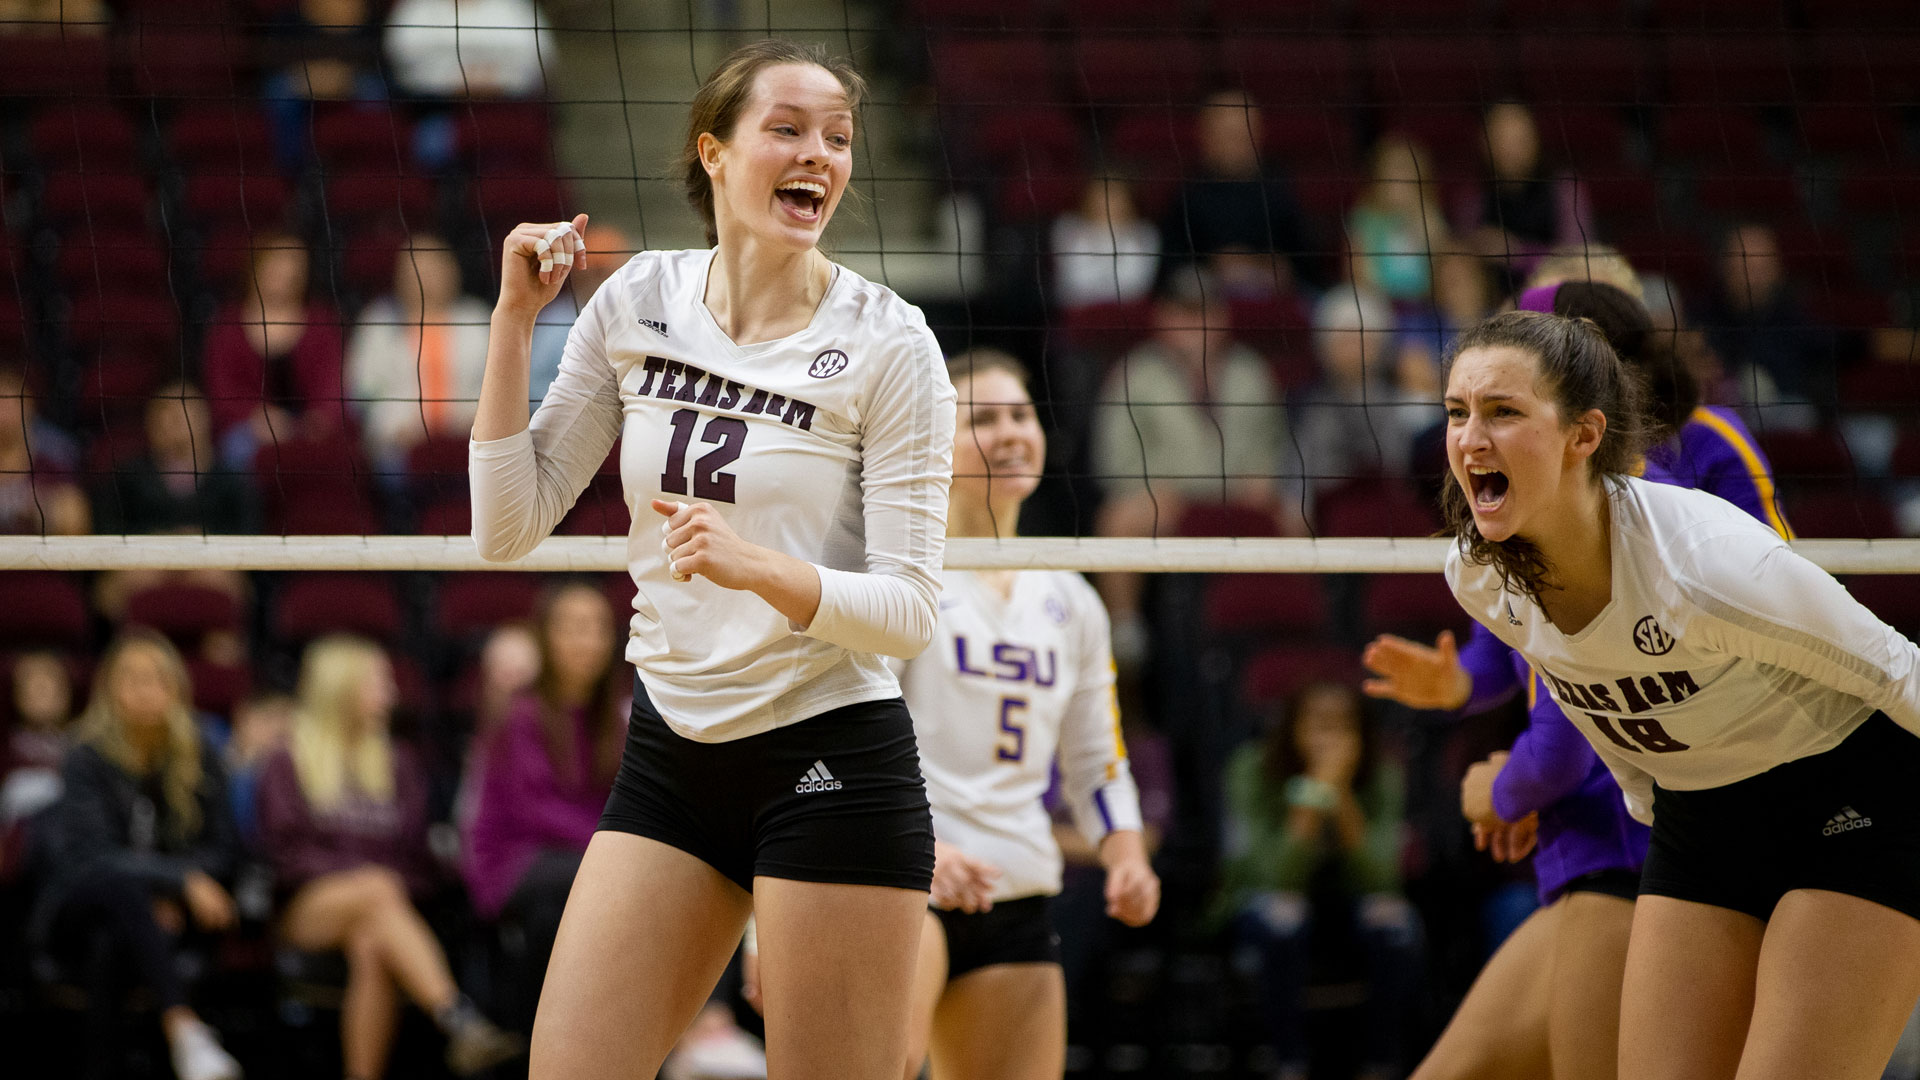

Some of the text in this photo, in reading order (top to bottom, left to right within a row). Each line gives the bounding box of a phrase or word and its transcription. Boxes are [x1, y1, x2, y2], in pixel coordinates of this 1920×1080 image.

[808, 349, 848, 379] SEC
[638, 355, 816, 431] TEXAS A&M
[661, 408, 748, 504] 12
[956, 635, 1056, 686] LSU
[1540, 663, 1701, 714] EXAS A&M
[995, 695, 1028, 764] 5
[1584, 711, 1690, 753] 18
[795, 779, 843, 794] adidas
[1822, 817, 1872, 836] adidas
